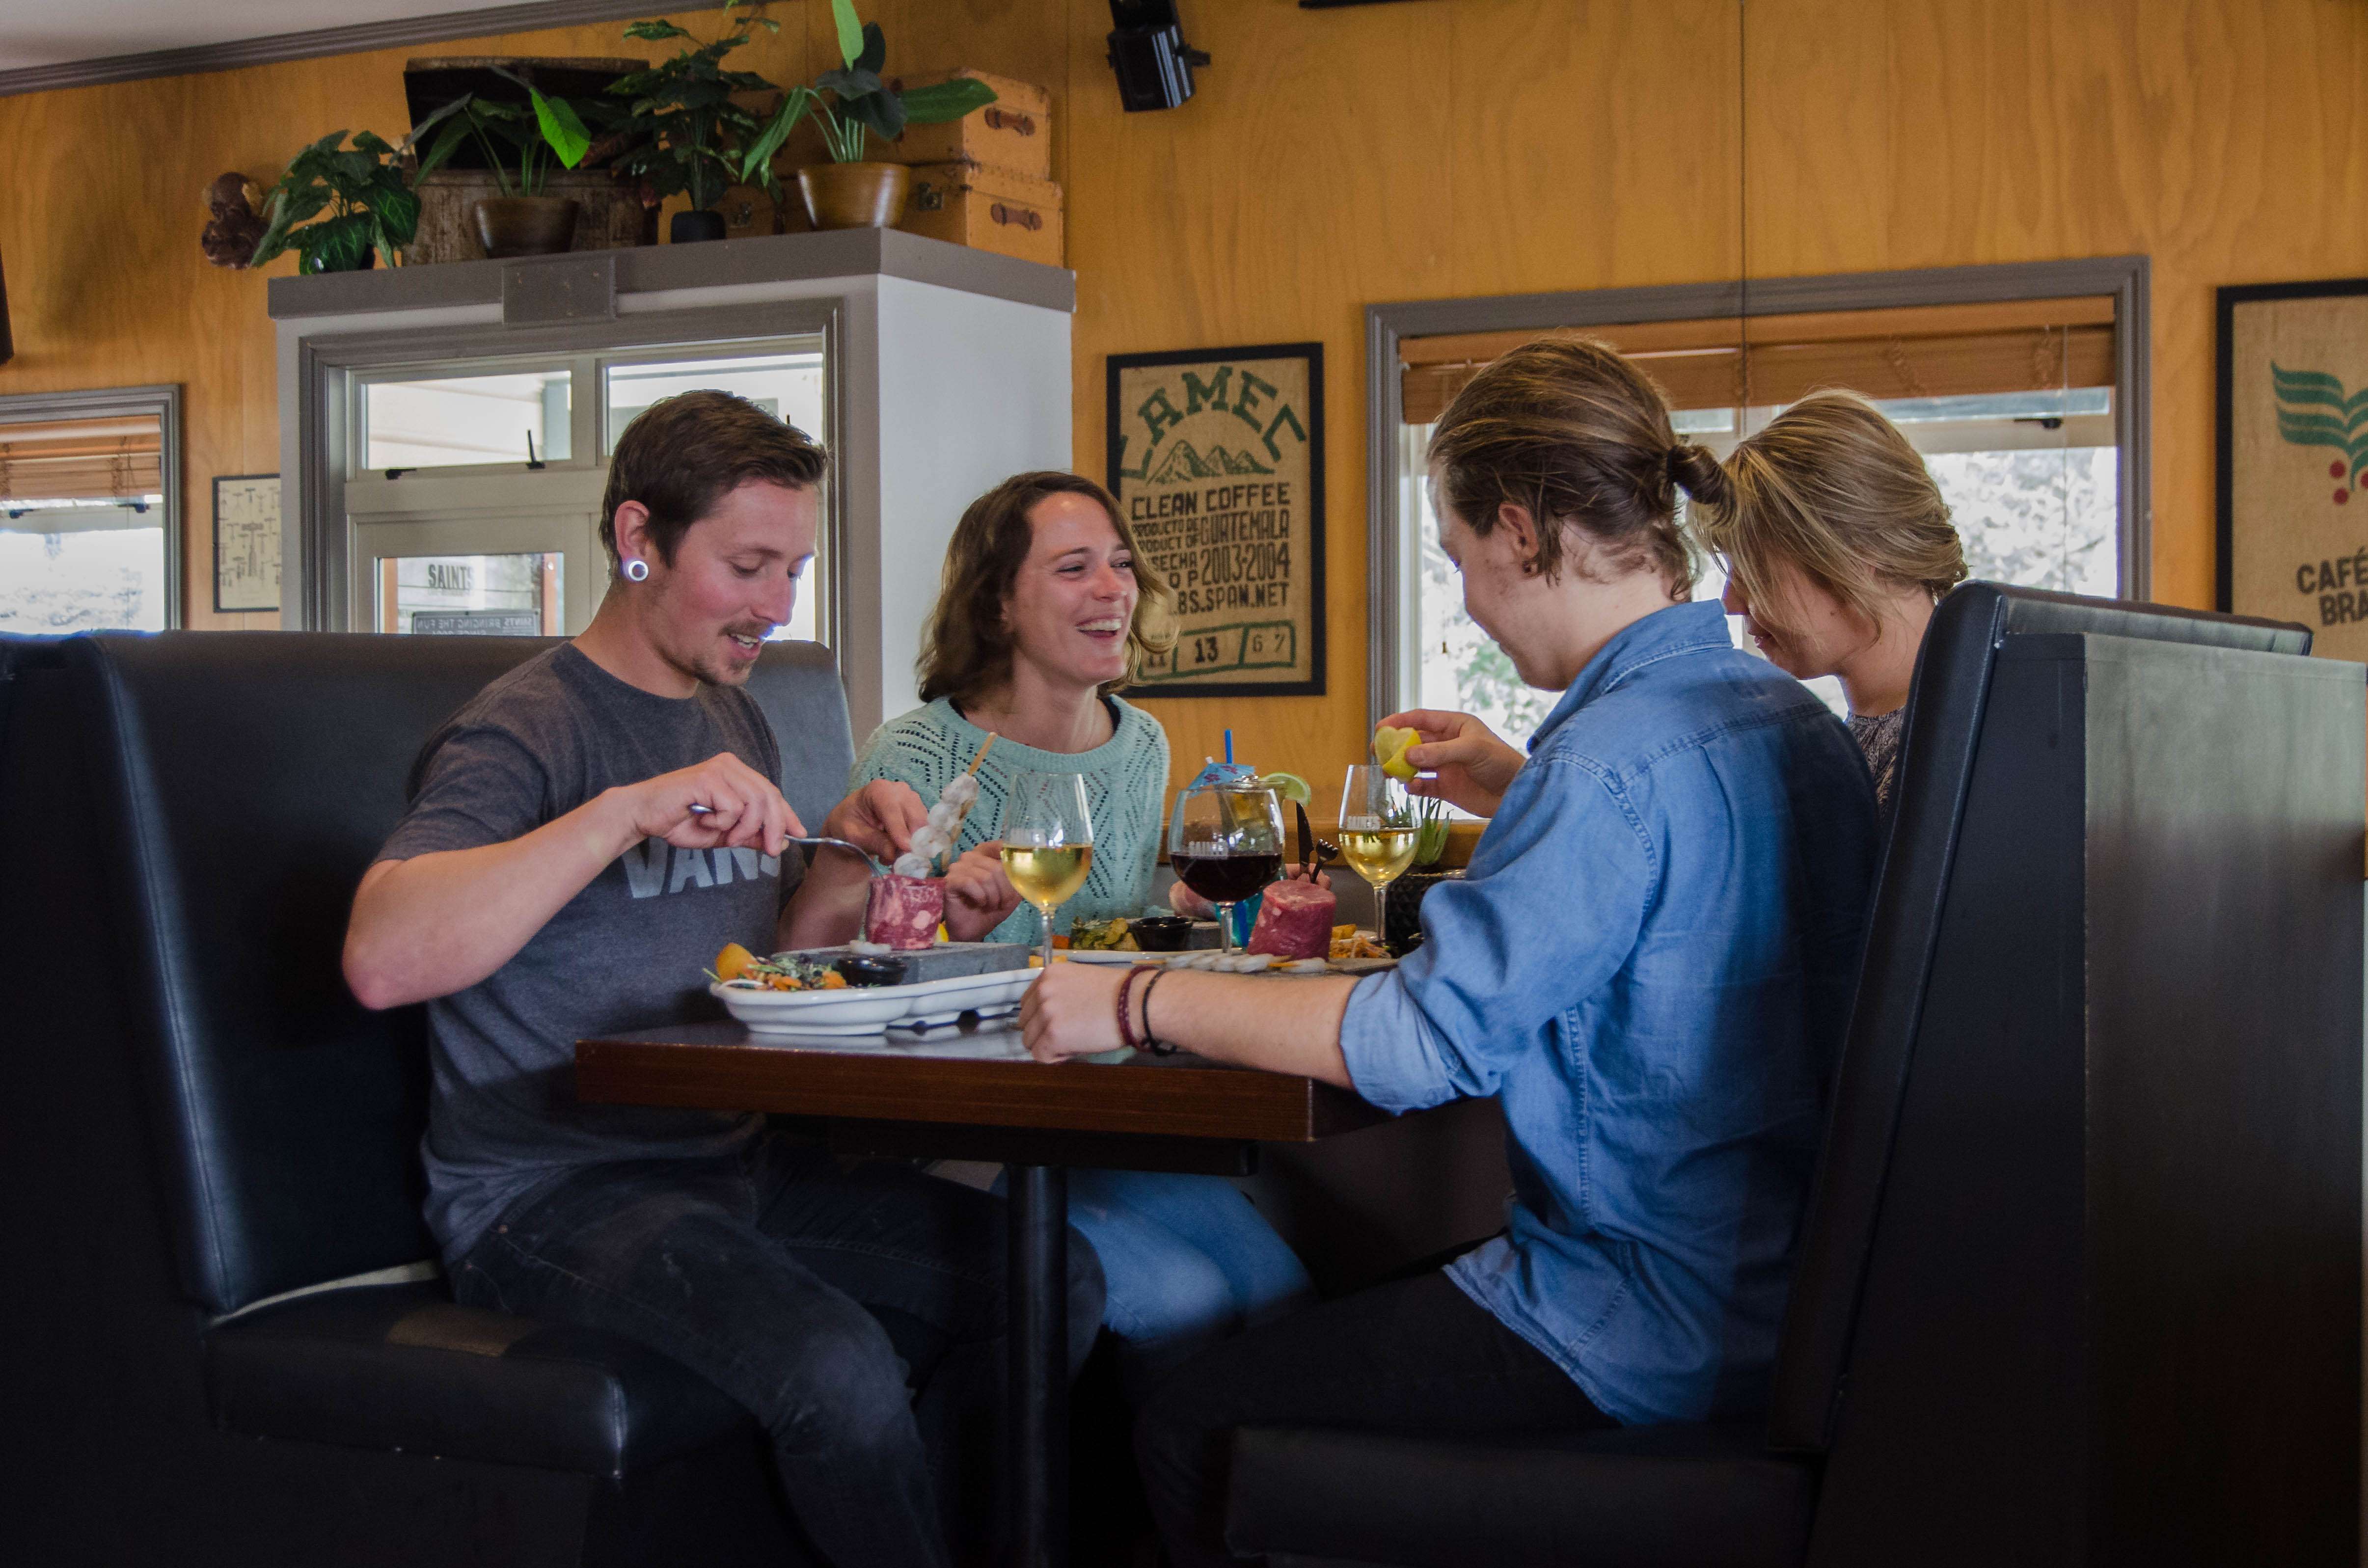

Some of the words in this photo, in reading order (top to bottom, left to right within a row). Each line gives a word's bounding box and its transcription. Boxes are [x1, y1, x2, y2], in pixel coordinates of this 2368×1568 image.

[1132, 491, 1197, 520] CLEAN
[1206, 483, 1290, 512] COFFEE
[1201, 509, 1289, 545] GUATEMALA
[428, 564, 473, 590] SAINTS
[1195, 636, 1219, 663] 13
